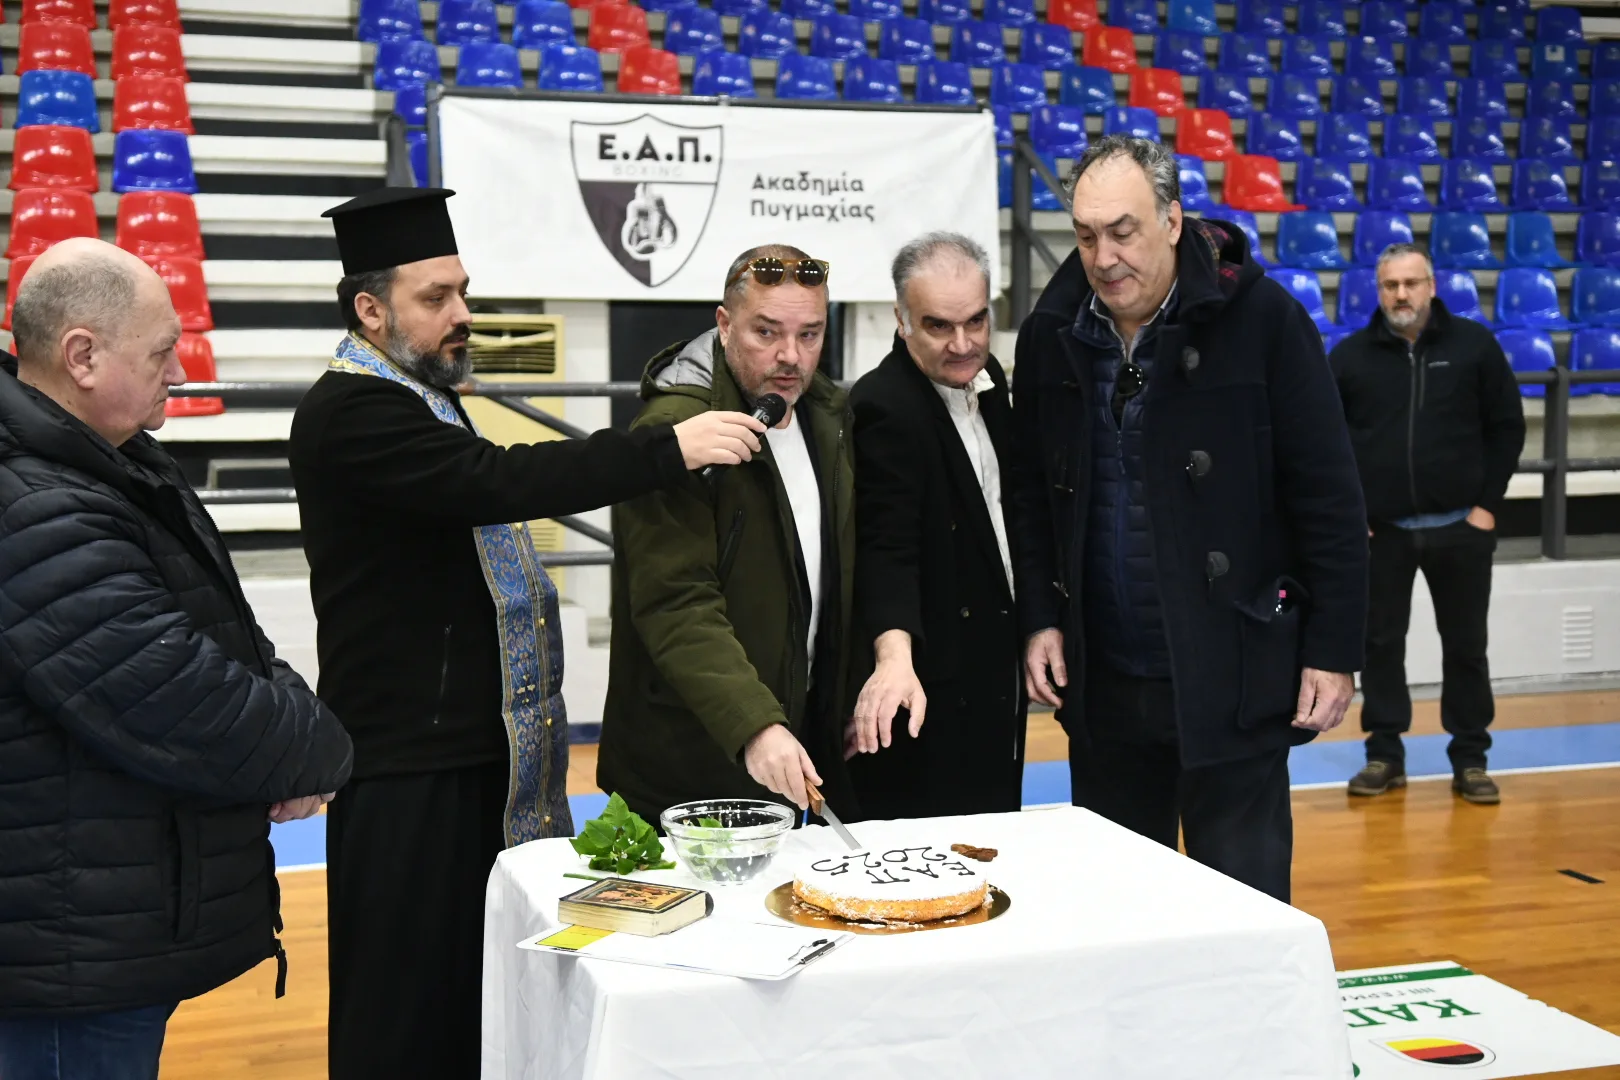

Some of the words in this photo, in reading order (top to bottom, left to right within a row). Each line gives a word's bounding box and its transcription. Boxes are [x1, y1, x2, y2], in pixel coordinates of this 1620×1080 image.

[599, 133, 712, 163] Ε.Α.Π.
[613, 165, 683, 177] BOXING
[752, 171, 864, 195] Ακαδημία
[751, 198, 874, 222] Πυγμαχίας
